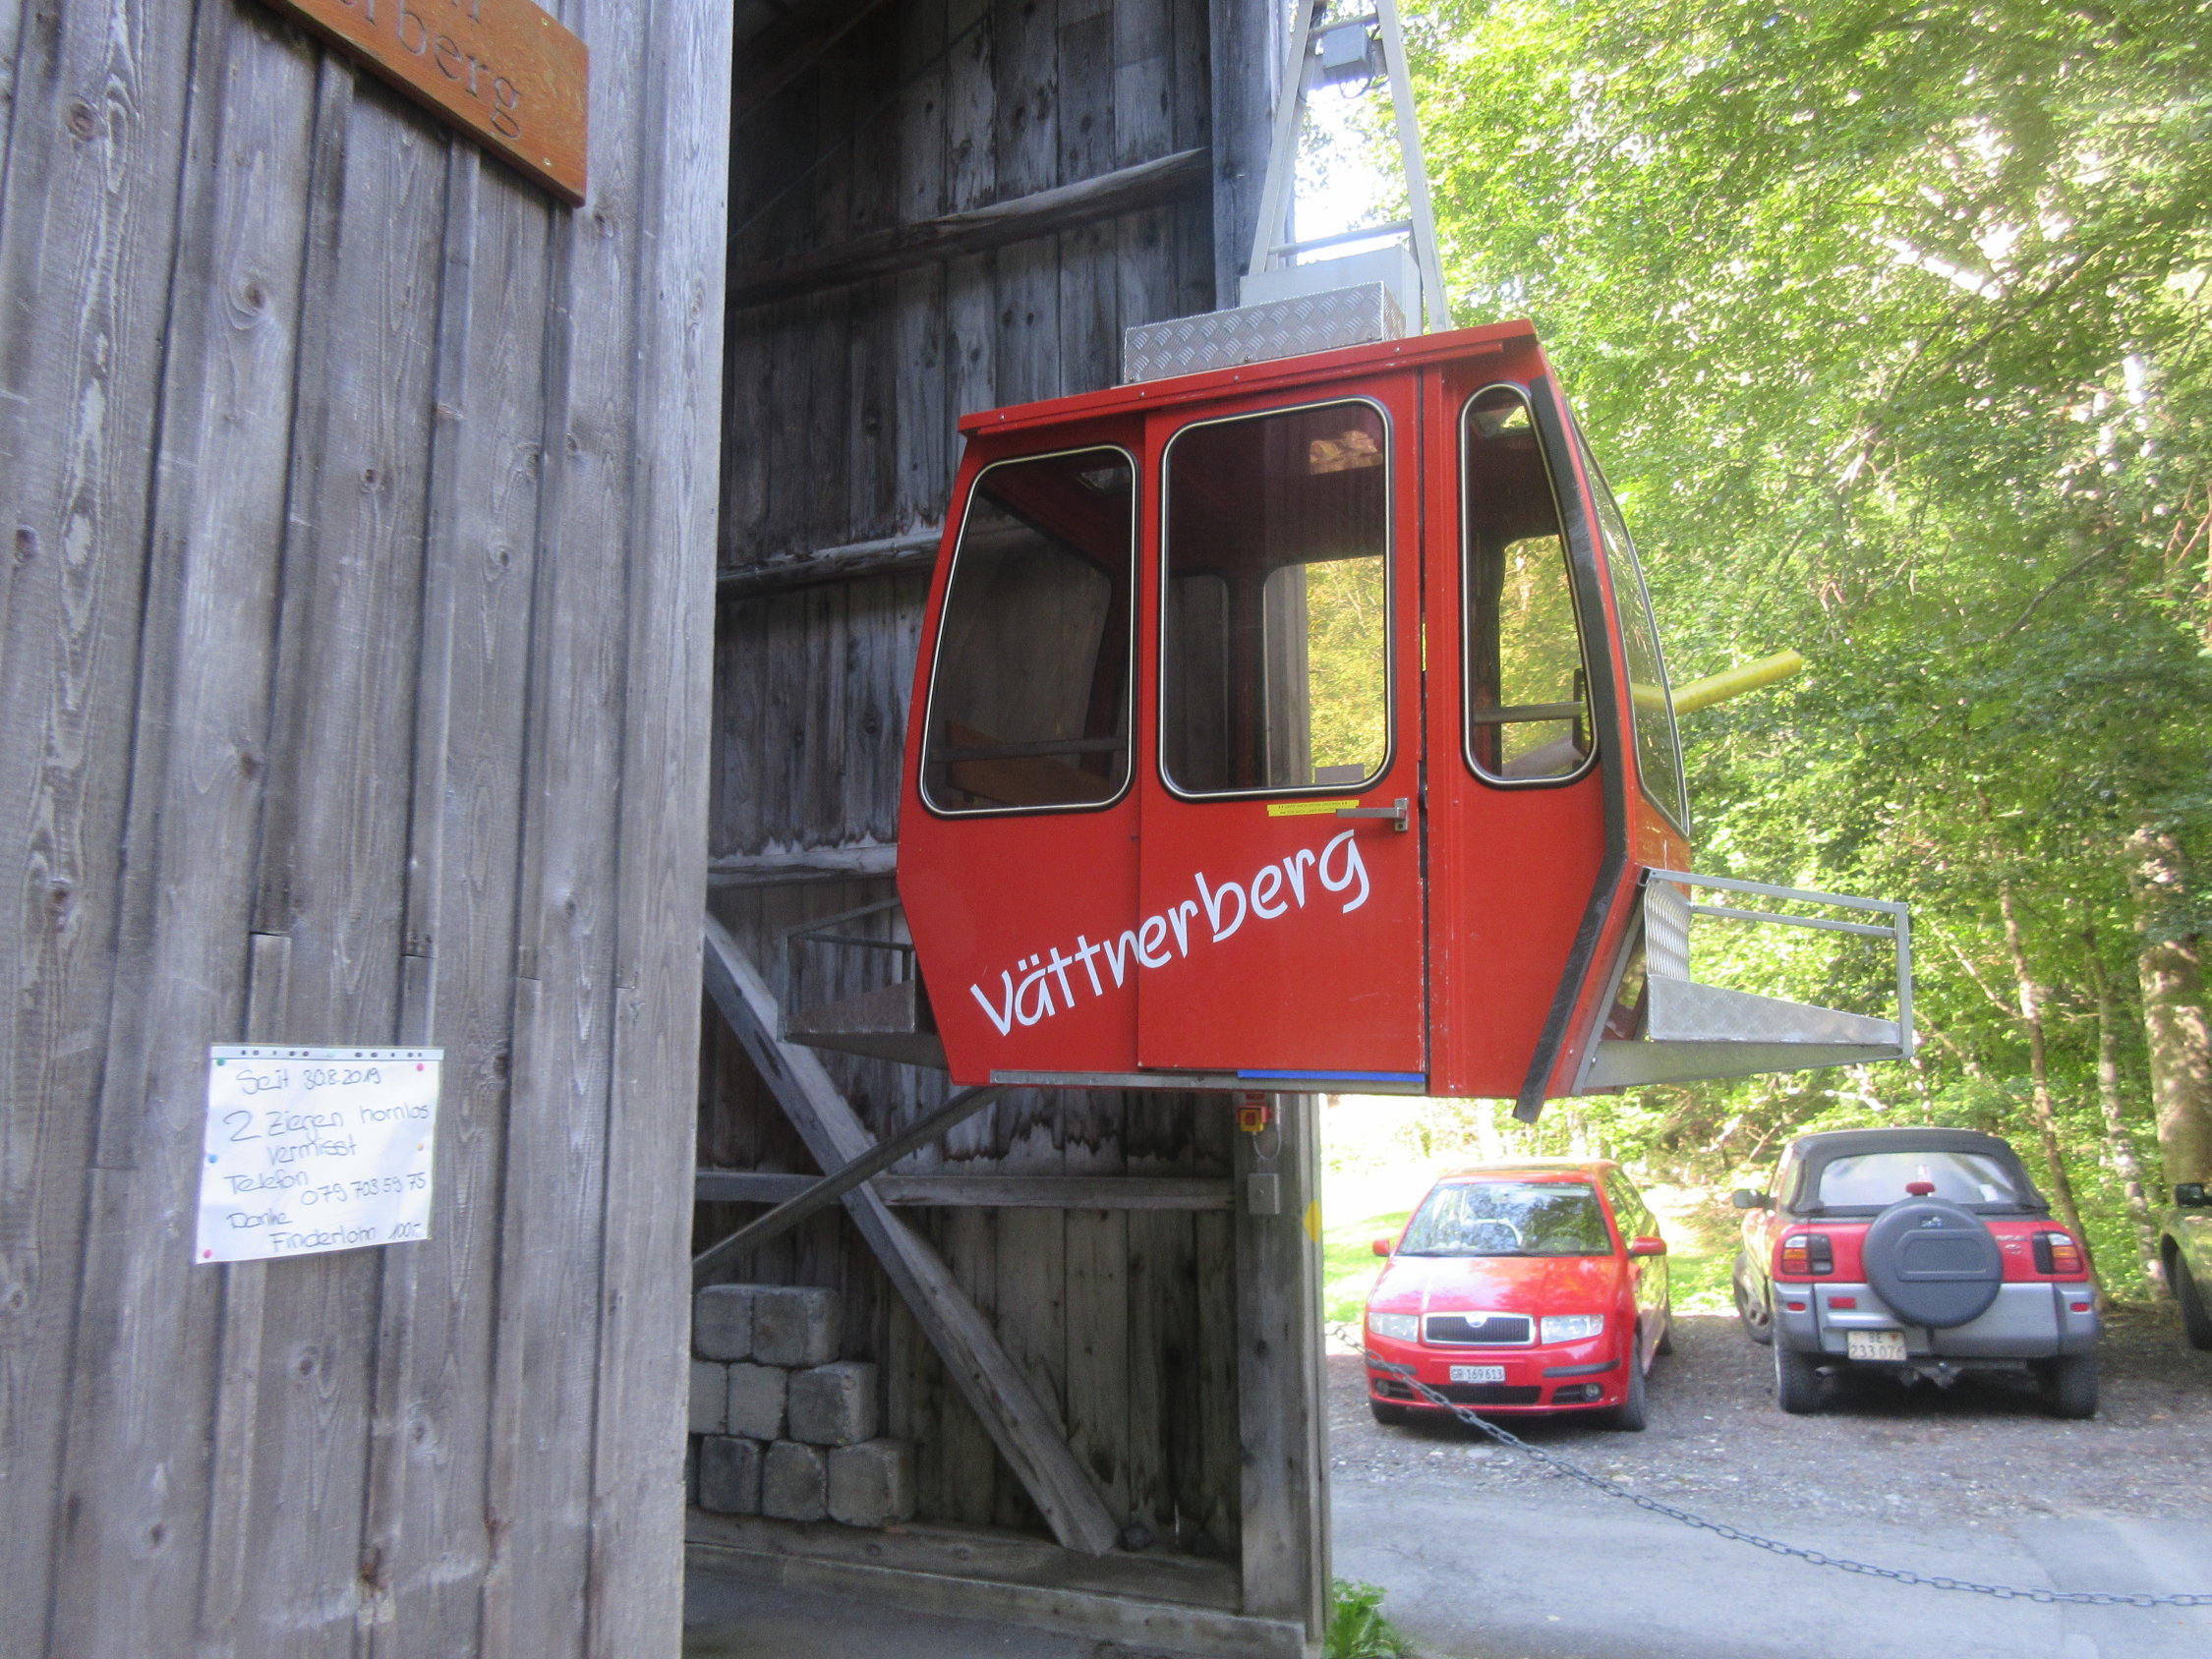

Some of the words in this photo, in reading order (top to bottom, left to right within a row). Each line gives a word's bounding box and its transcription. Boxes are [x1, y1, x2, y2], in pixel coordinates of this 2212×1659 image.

[969, 829, 1370, 1037] Vättnerberg
[235, 1068, 289, 1095] Seit
[222, 1110, 262, 1142] 2
[359, 1102, 429, 1124] hornlos
[223, 1169, 310, 1195] Telefon
[226, 1207, 293, 1230] Danke
